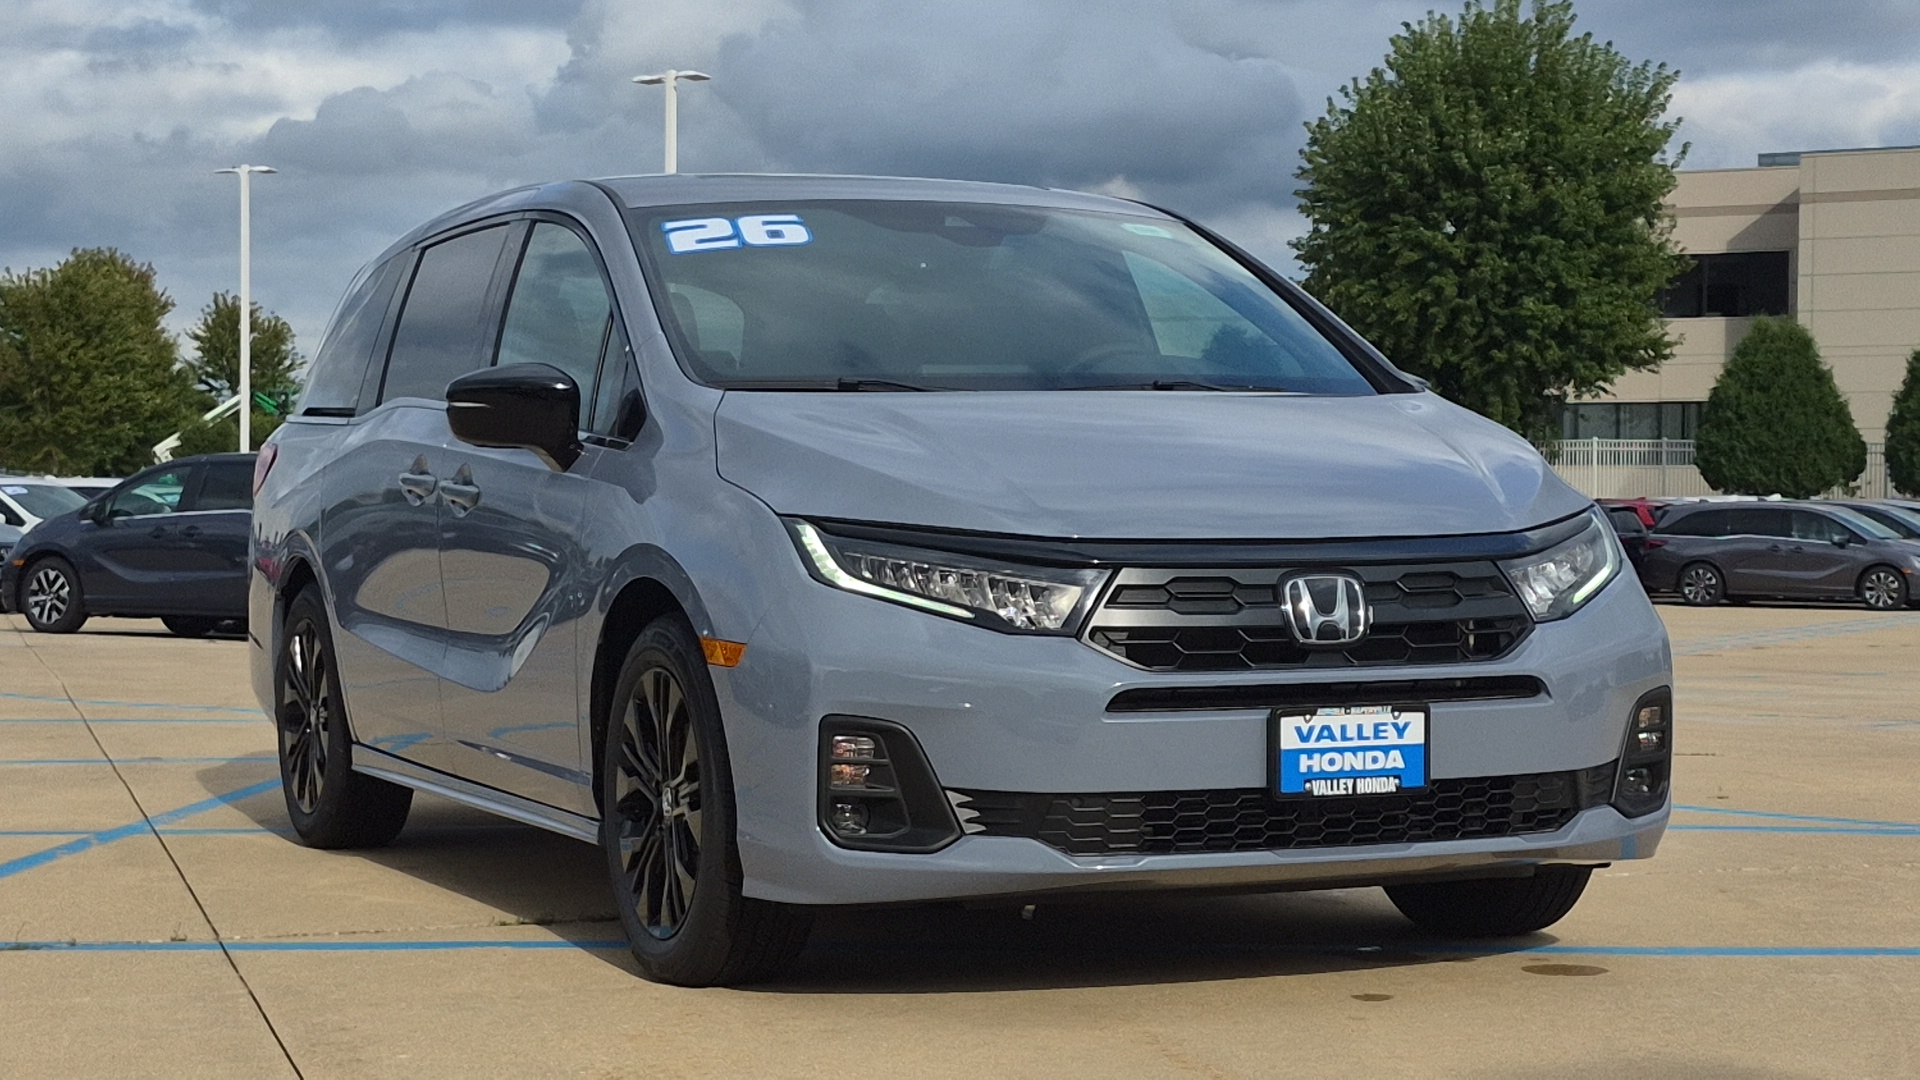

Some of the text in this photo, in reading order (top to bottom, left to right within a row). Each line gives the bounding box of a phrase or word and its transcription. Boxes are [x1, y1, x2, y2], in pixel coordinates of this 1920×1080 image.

[661, 215, 813, 254] 26
[1294, 721, 1411, 743] VALLEY
[1299, 750, 1405, 773] HONDA
[1312, 776, 1396, 796] VALLEY HONDA
